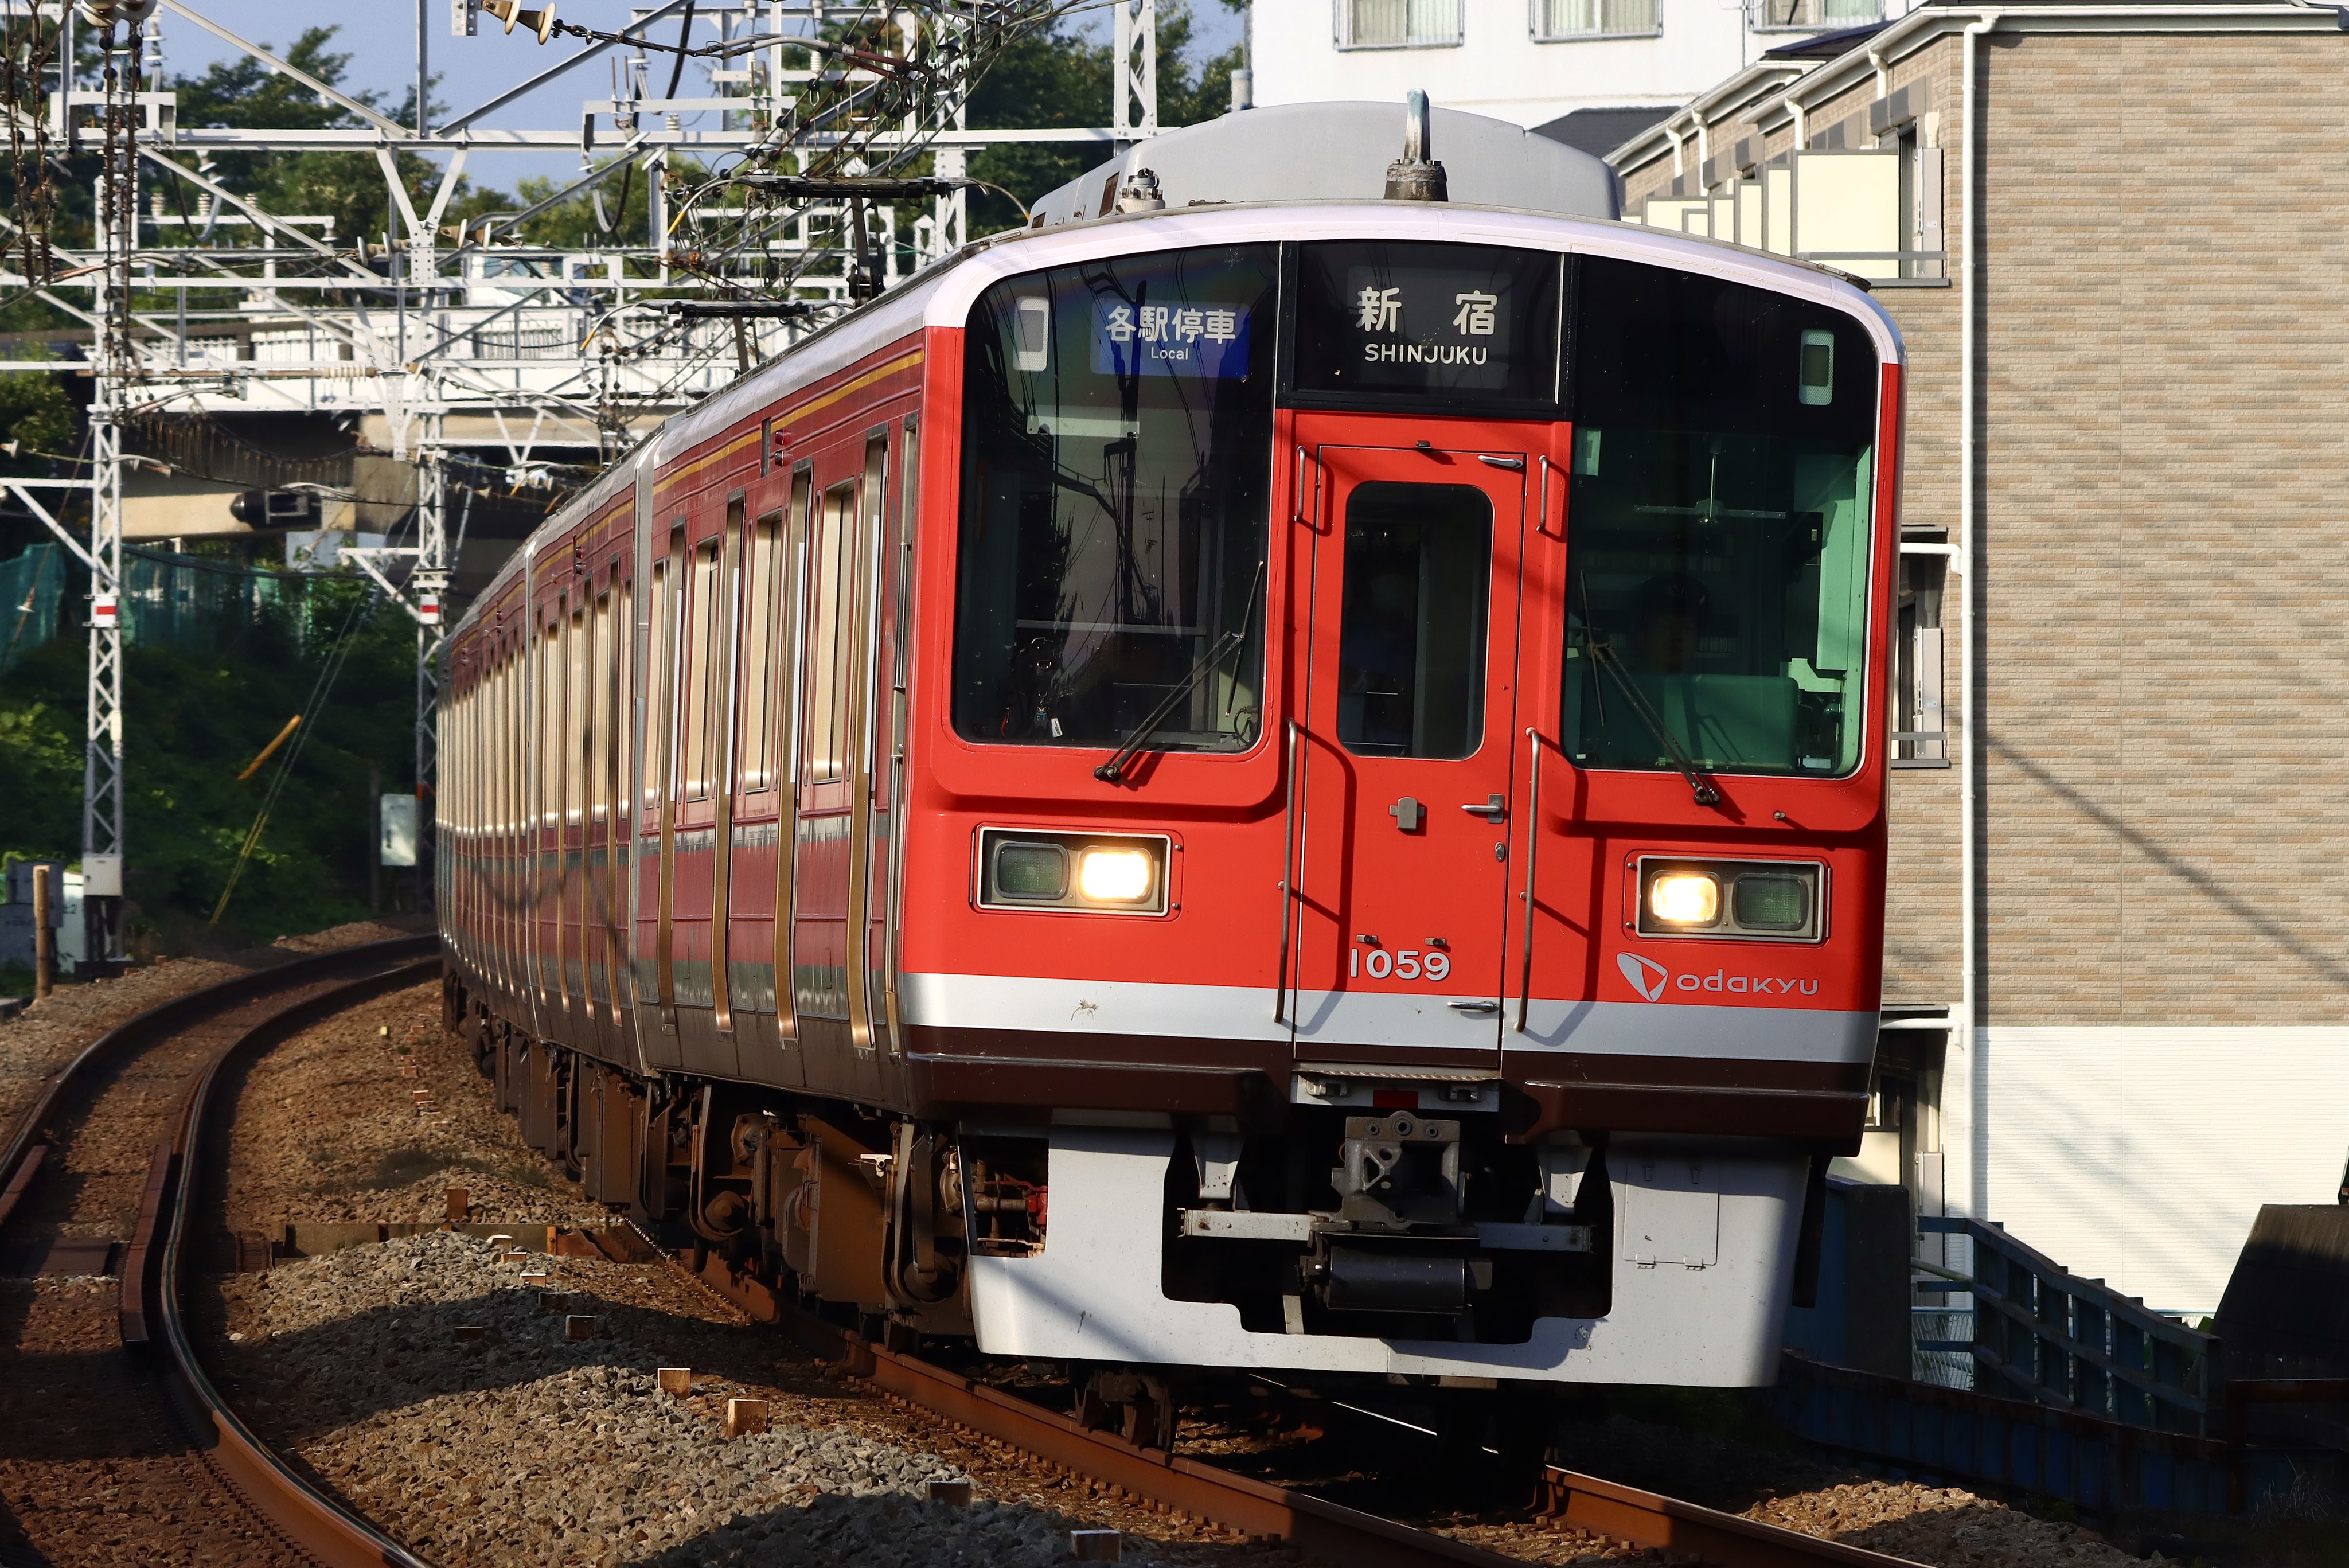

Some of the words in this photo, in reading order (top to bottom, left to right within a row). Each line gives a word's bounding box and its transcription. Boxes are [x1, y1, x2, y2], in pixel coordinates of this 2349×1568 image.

[1105, 306, 1236, 344] 各駅停車
[1355, 286, 1497, 335] 新宿
[1150, 346, 1188, 360] Local
[1364, 344, 1487, 365] SHINJUKU
[1350, 949, 1450, 981] 1059
[1676, 969, 1819, 995] odakyu
